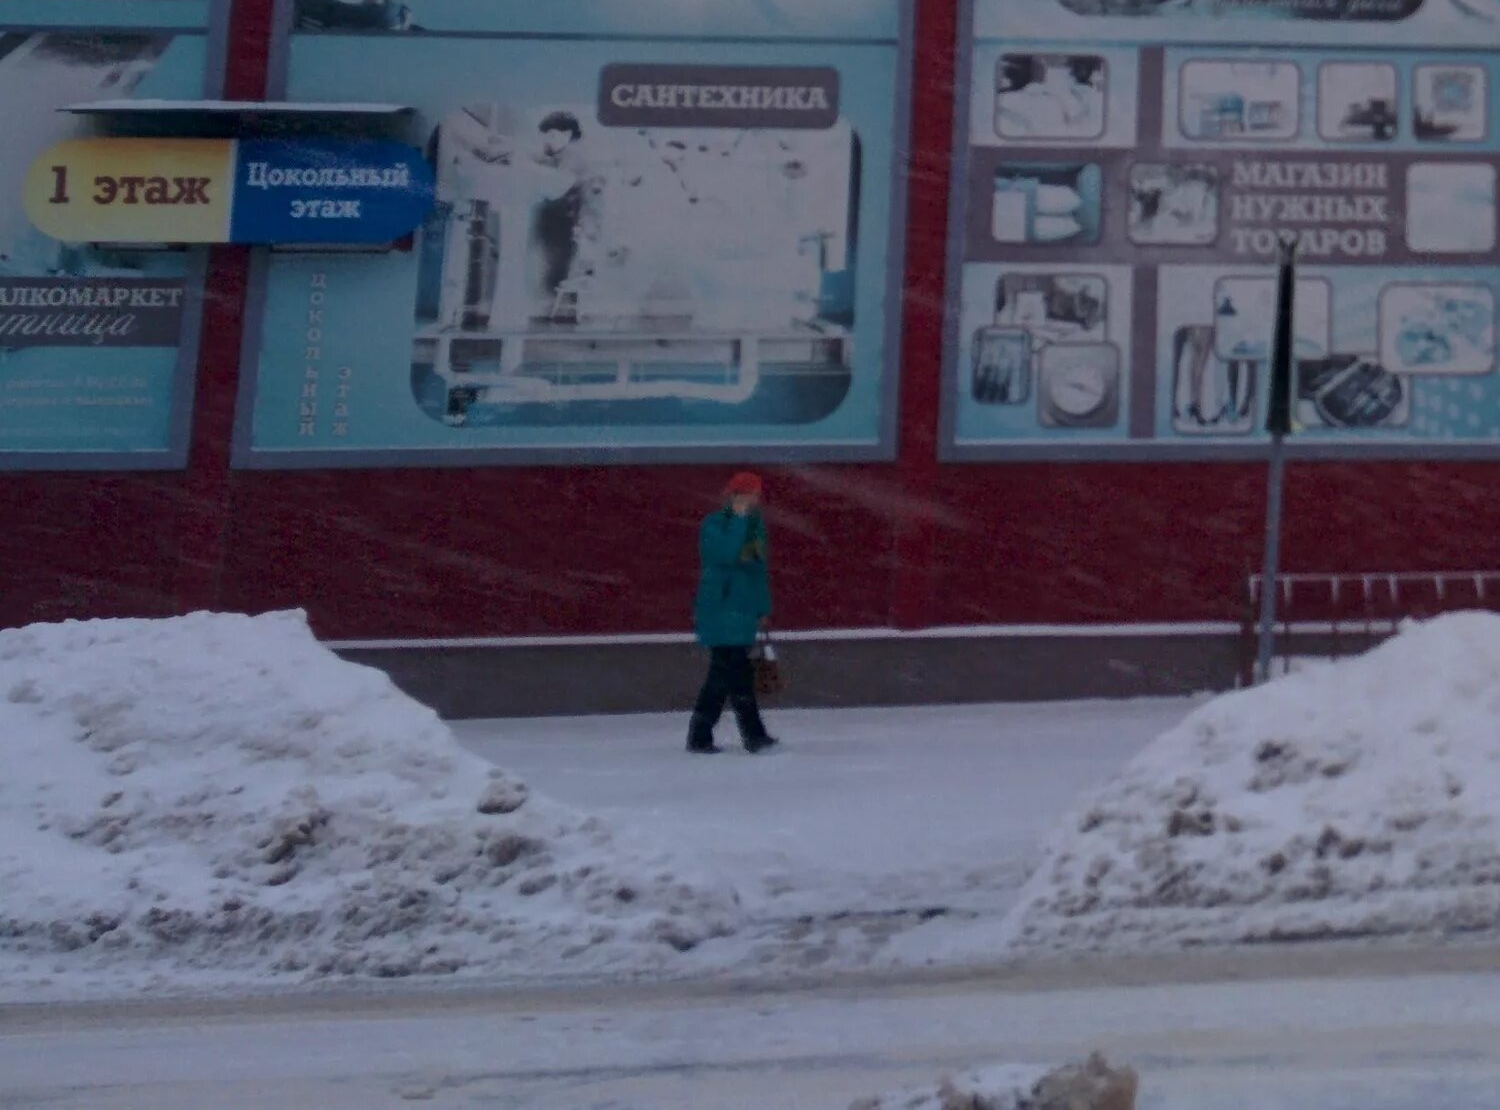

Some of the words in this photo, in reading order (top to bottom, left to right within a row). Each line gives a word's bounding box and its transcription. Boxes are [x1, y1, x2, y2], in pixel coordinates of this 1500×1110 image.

[610, 82, 831, 111] САНТЕХНИКА
[49, 166, 70, 204] 1
[93, 174, 210, 206] этаж
[247, 161, 410, 189] Цокольный
[1231, 161, 1388, 188] МАГАЗИН
[290, 197, 361, 219] этаж
[1231, 195, 1390, 223] НУЖНЫХ
[0, 313, 138, 345] тница
